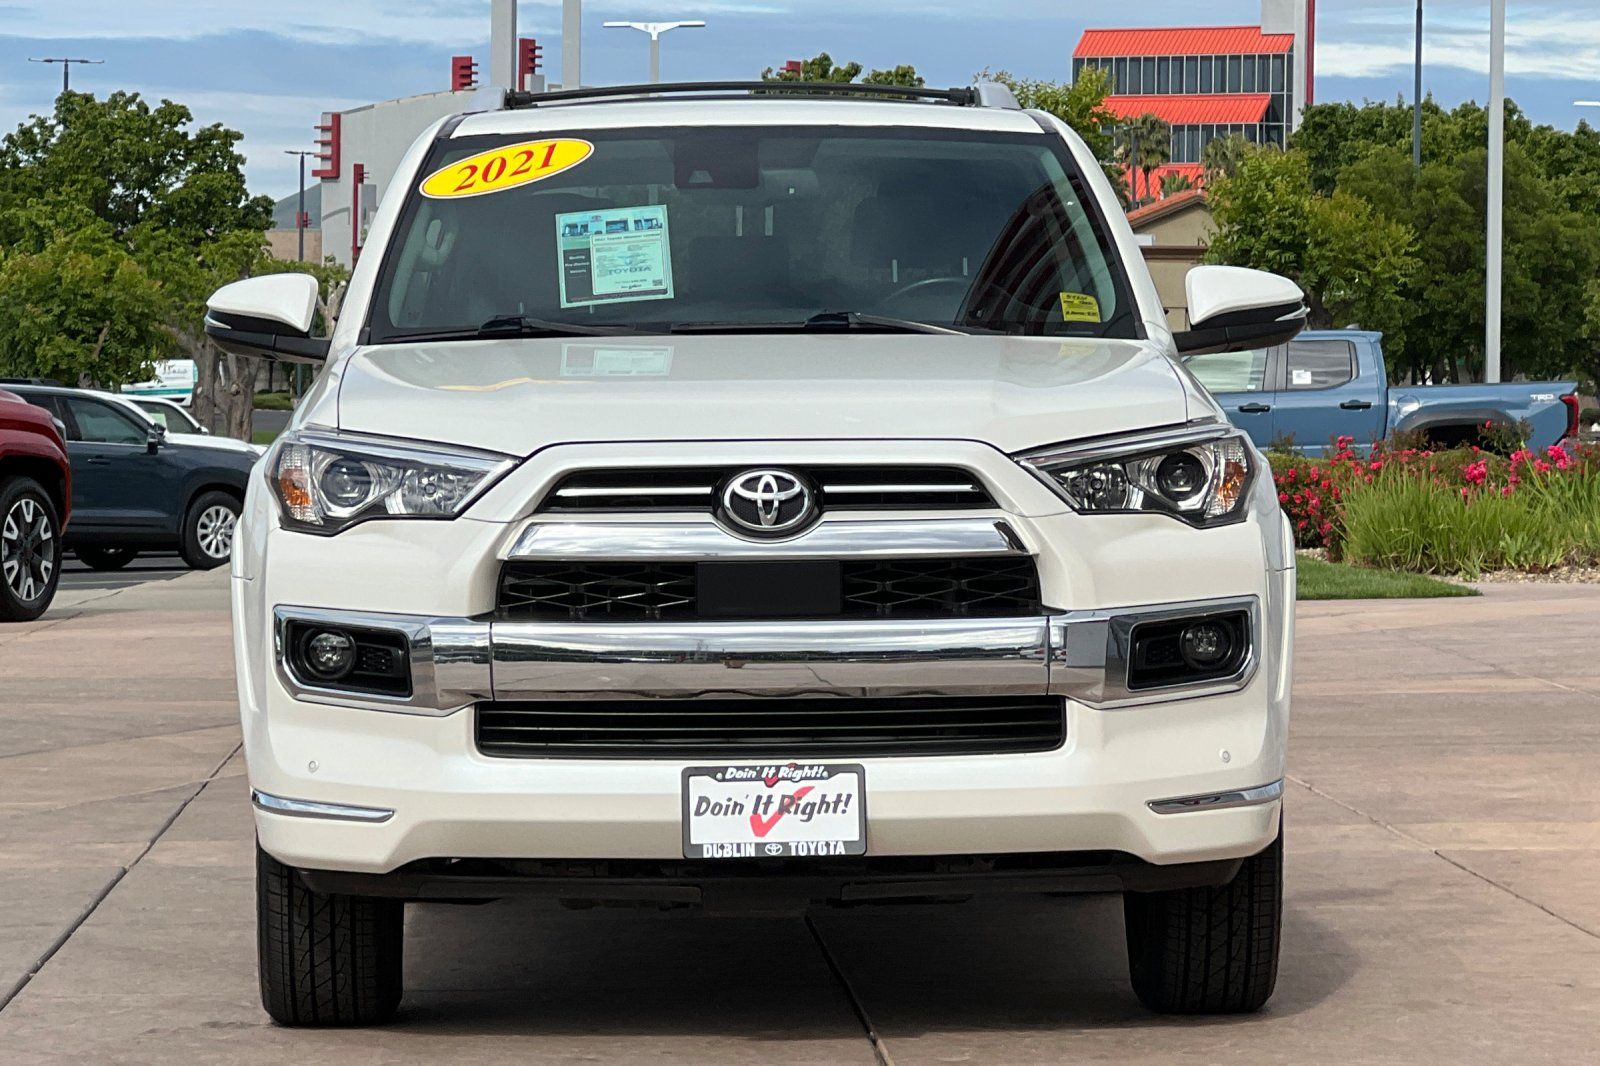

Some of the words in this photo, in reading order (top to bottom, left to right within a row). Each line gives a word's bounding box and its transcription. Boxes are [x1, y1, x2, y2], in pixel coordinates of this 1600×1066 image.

[453, 143, 557, 192] 2021
[725, 767, 759, 779] Doin'
[761, 766, 775, 779] It
[778, 765, 824, 782] Right!
[694, 794, 749, 817] Doin'
[752, 794, 774, 815] It
[778, 793, 852, 822] Right!
[703, 843, 755, 858] DUBLIN
[789, 841, 846, 856] TOYOTA
